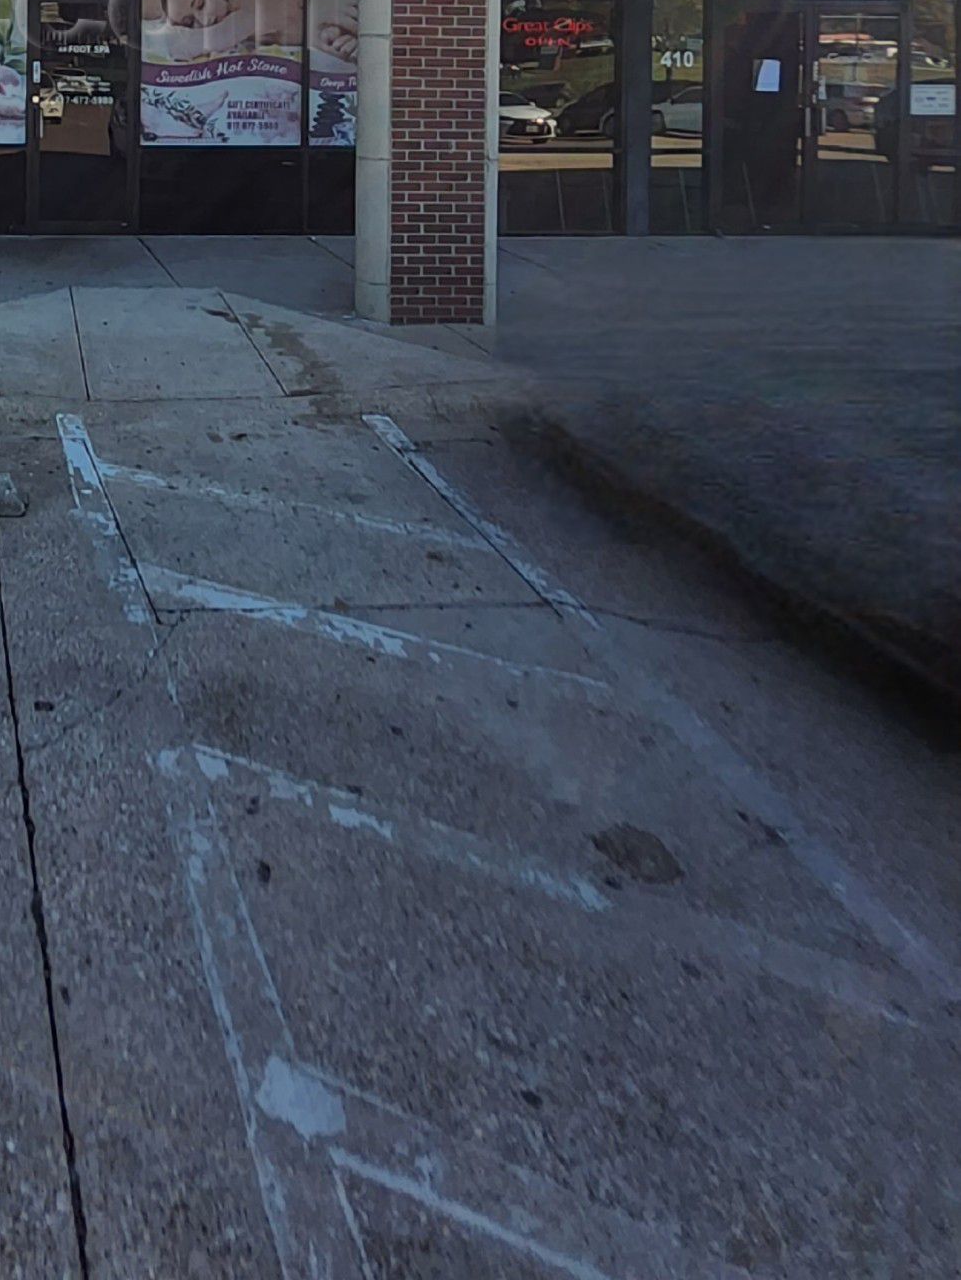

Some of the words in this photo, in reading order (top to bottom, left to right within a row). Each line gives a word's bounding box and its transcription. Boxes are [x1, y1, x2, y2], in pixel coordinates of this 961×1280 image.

[503, 17, 549, 33] Great
[553, 17, 594, 36] Clips
[68, 45, 91, 53] FOOT
[93, 44, 110, 53] SPA
[660, 51, 694, 68] 410
[155, 66, 212, 83] Swedish
[216, 60, 244, 76] Hot
[247, 58, 288, 74] Stone
